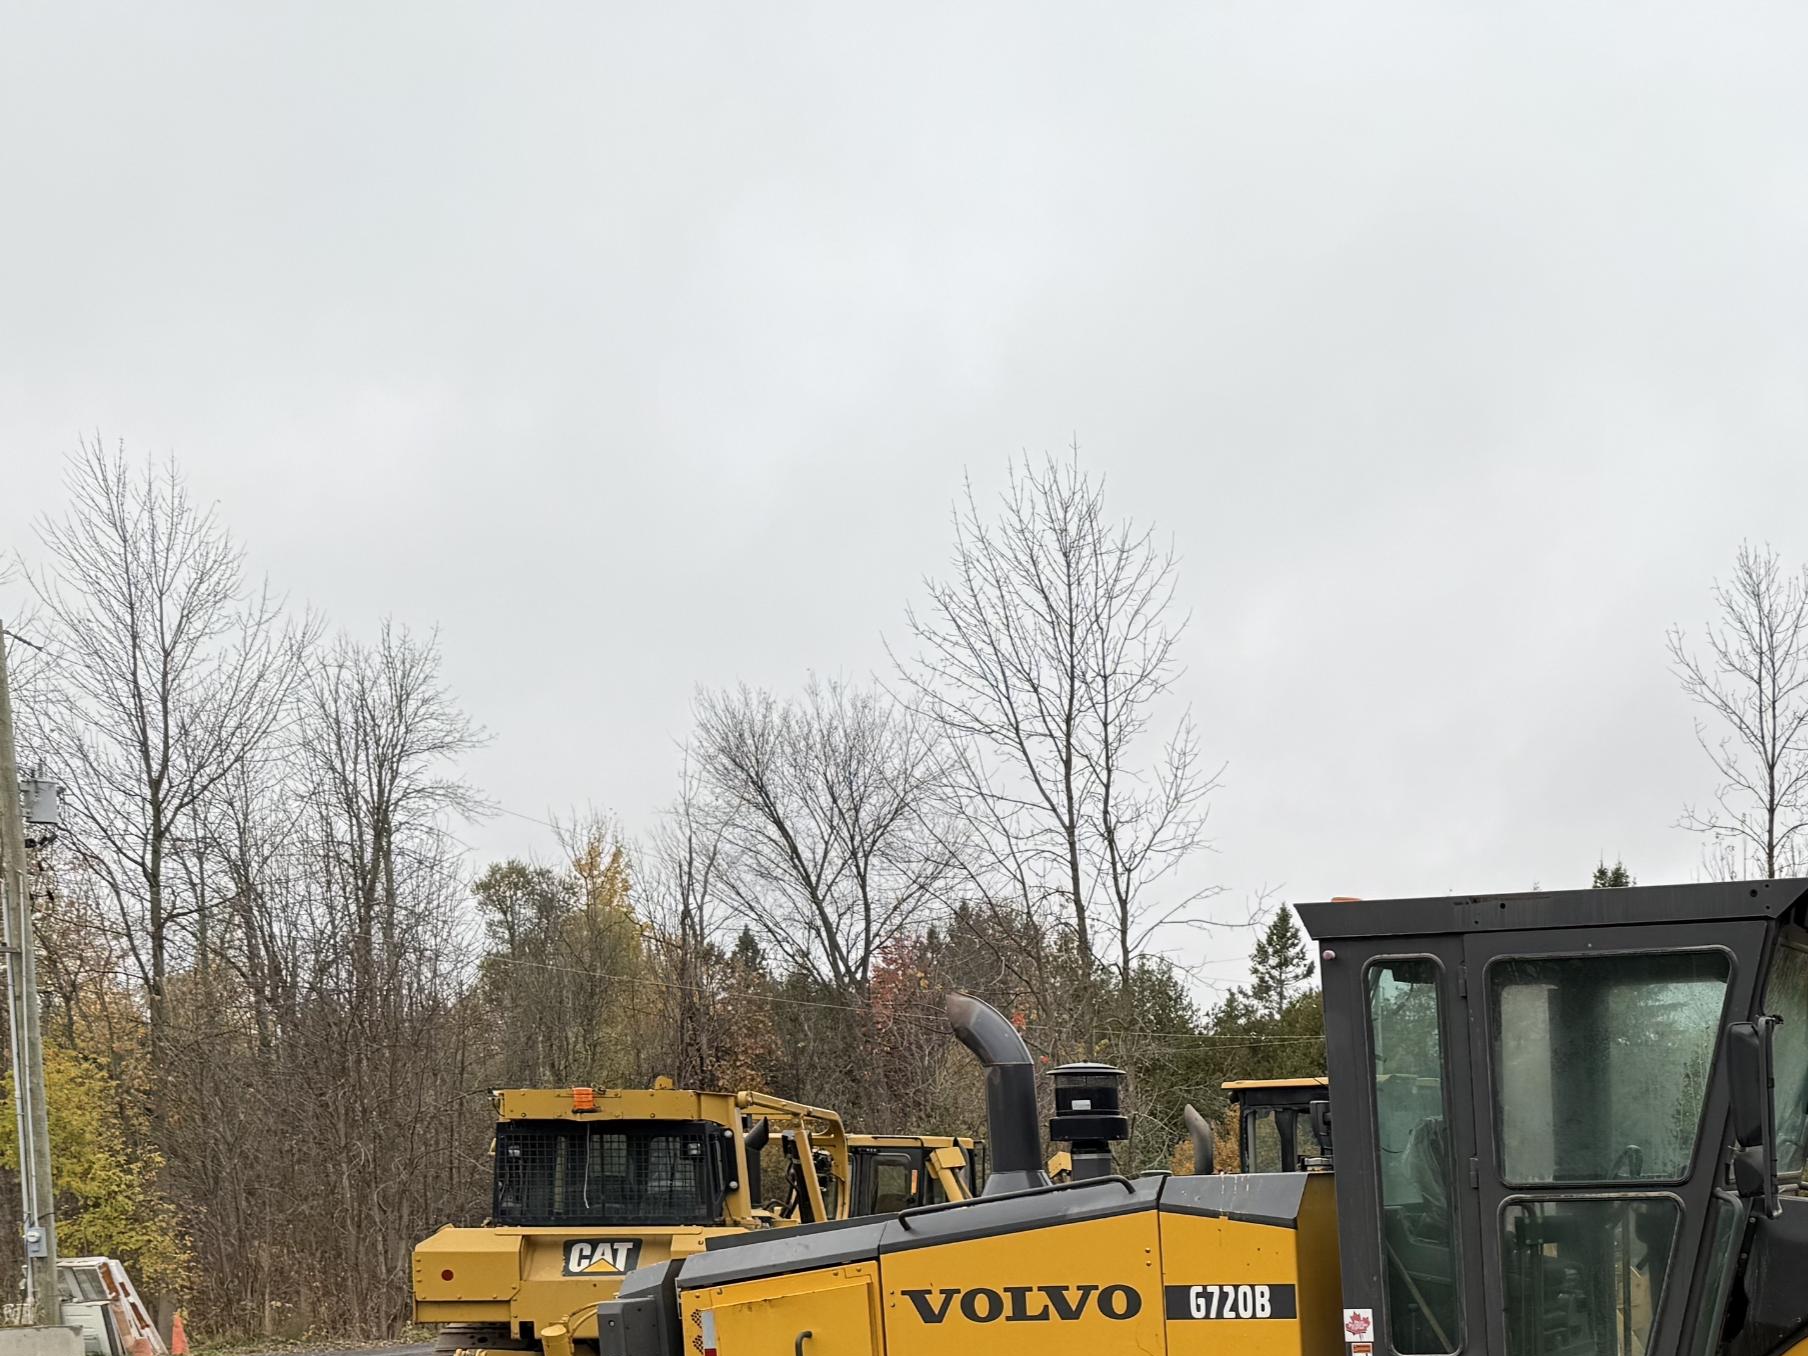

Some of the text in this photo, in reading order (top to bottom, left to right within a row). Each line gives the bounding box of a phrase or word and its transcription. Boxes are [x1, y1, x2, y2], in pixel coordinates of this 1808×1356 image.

[568, 1242, 634, 1272] CAT
[900, 1284, 1142, 1324] VOLVO
[1188, 1284, 1272, 1319] G720B
